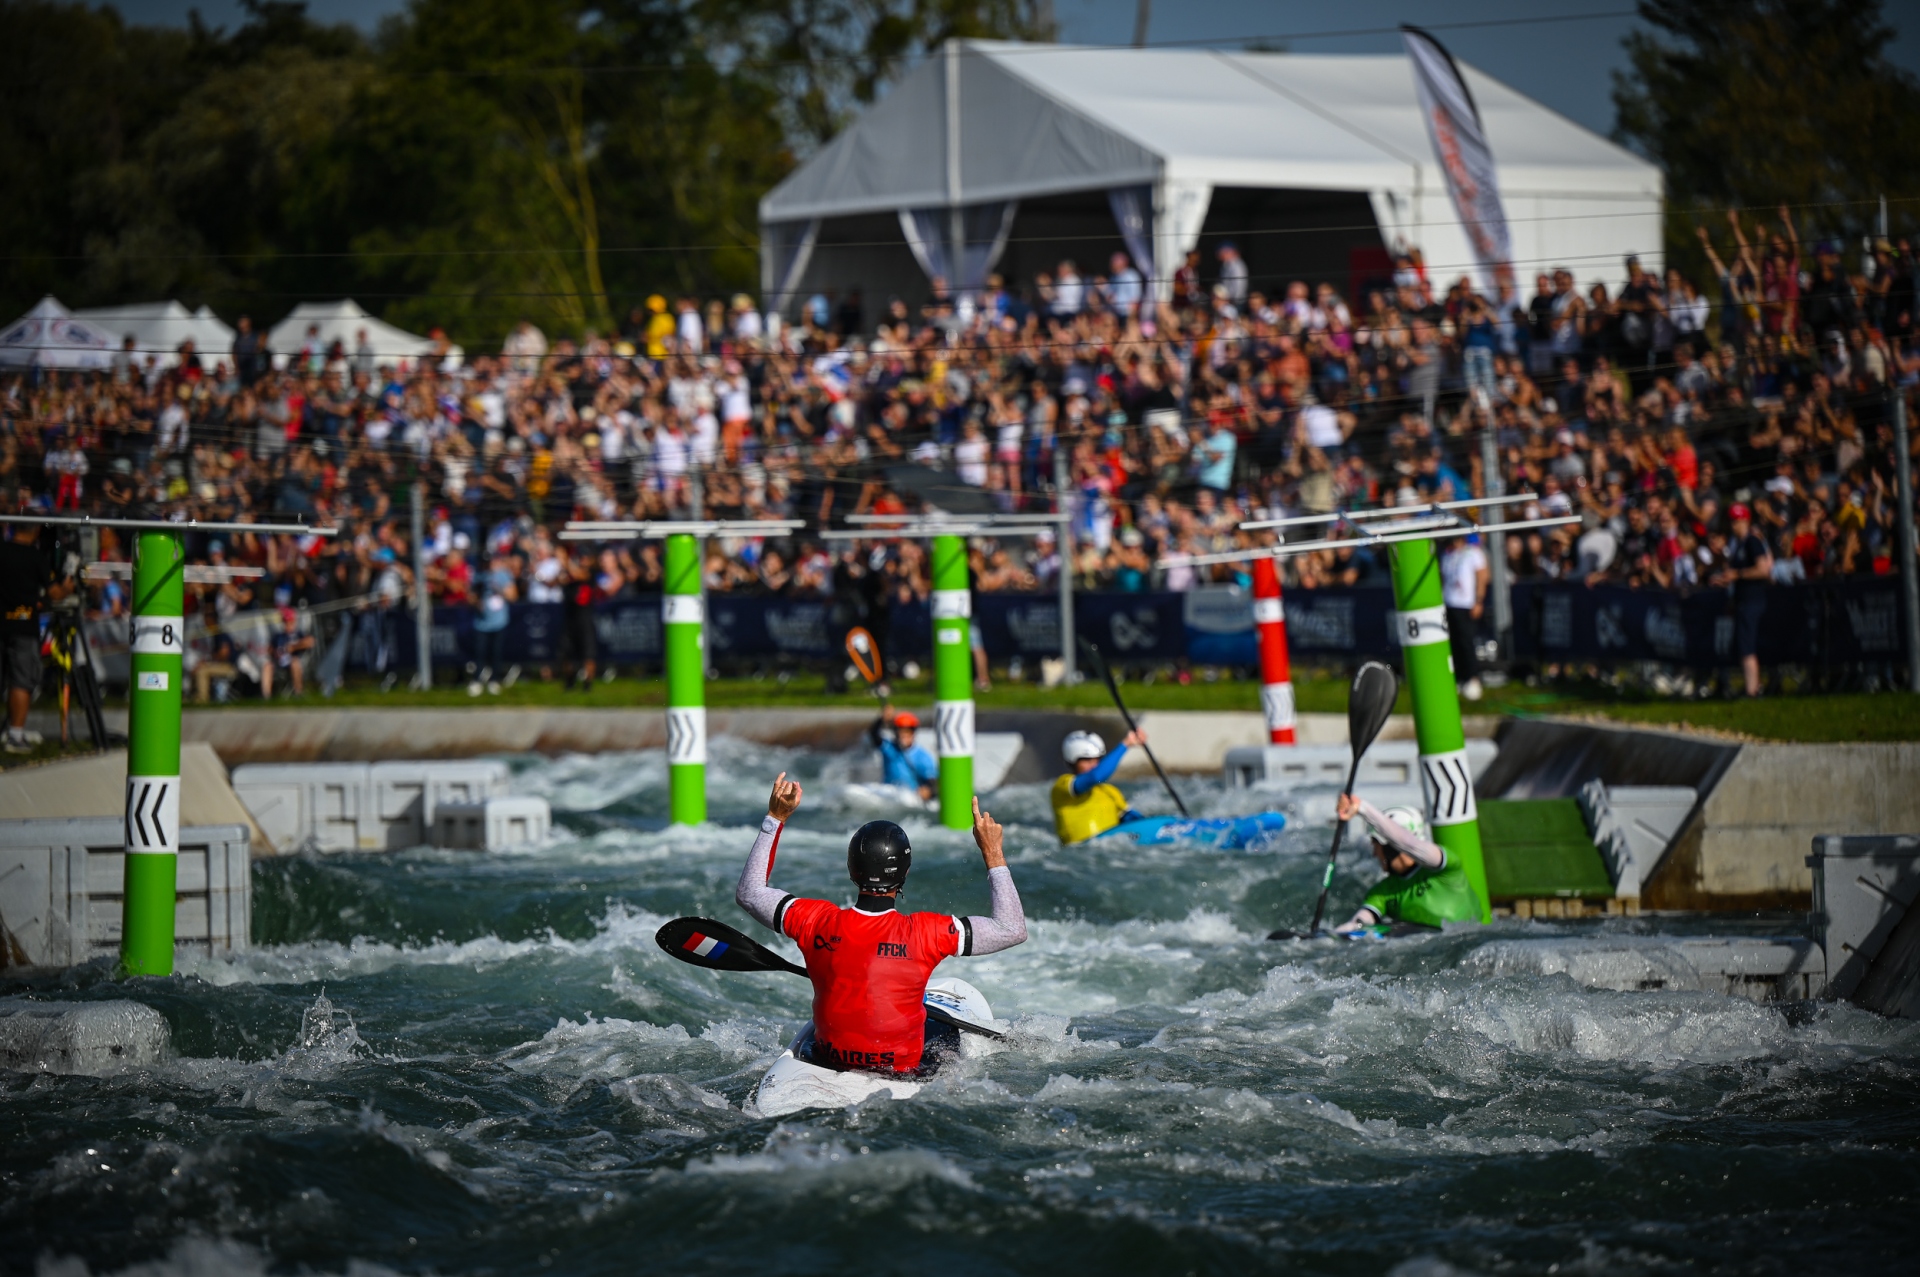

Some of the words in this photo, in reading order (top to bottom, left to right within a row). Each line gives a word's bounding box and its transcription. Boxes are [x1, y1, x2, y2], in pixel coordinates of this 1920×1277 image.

[162, 624, 173, 645] 8
[1408, 618, 1419, 639] 8
[877, 942, 908, 958] FFCK
